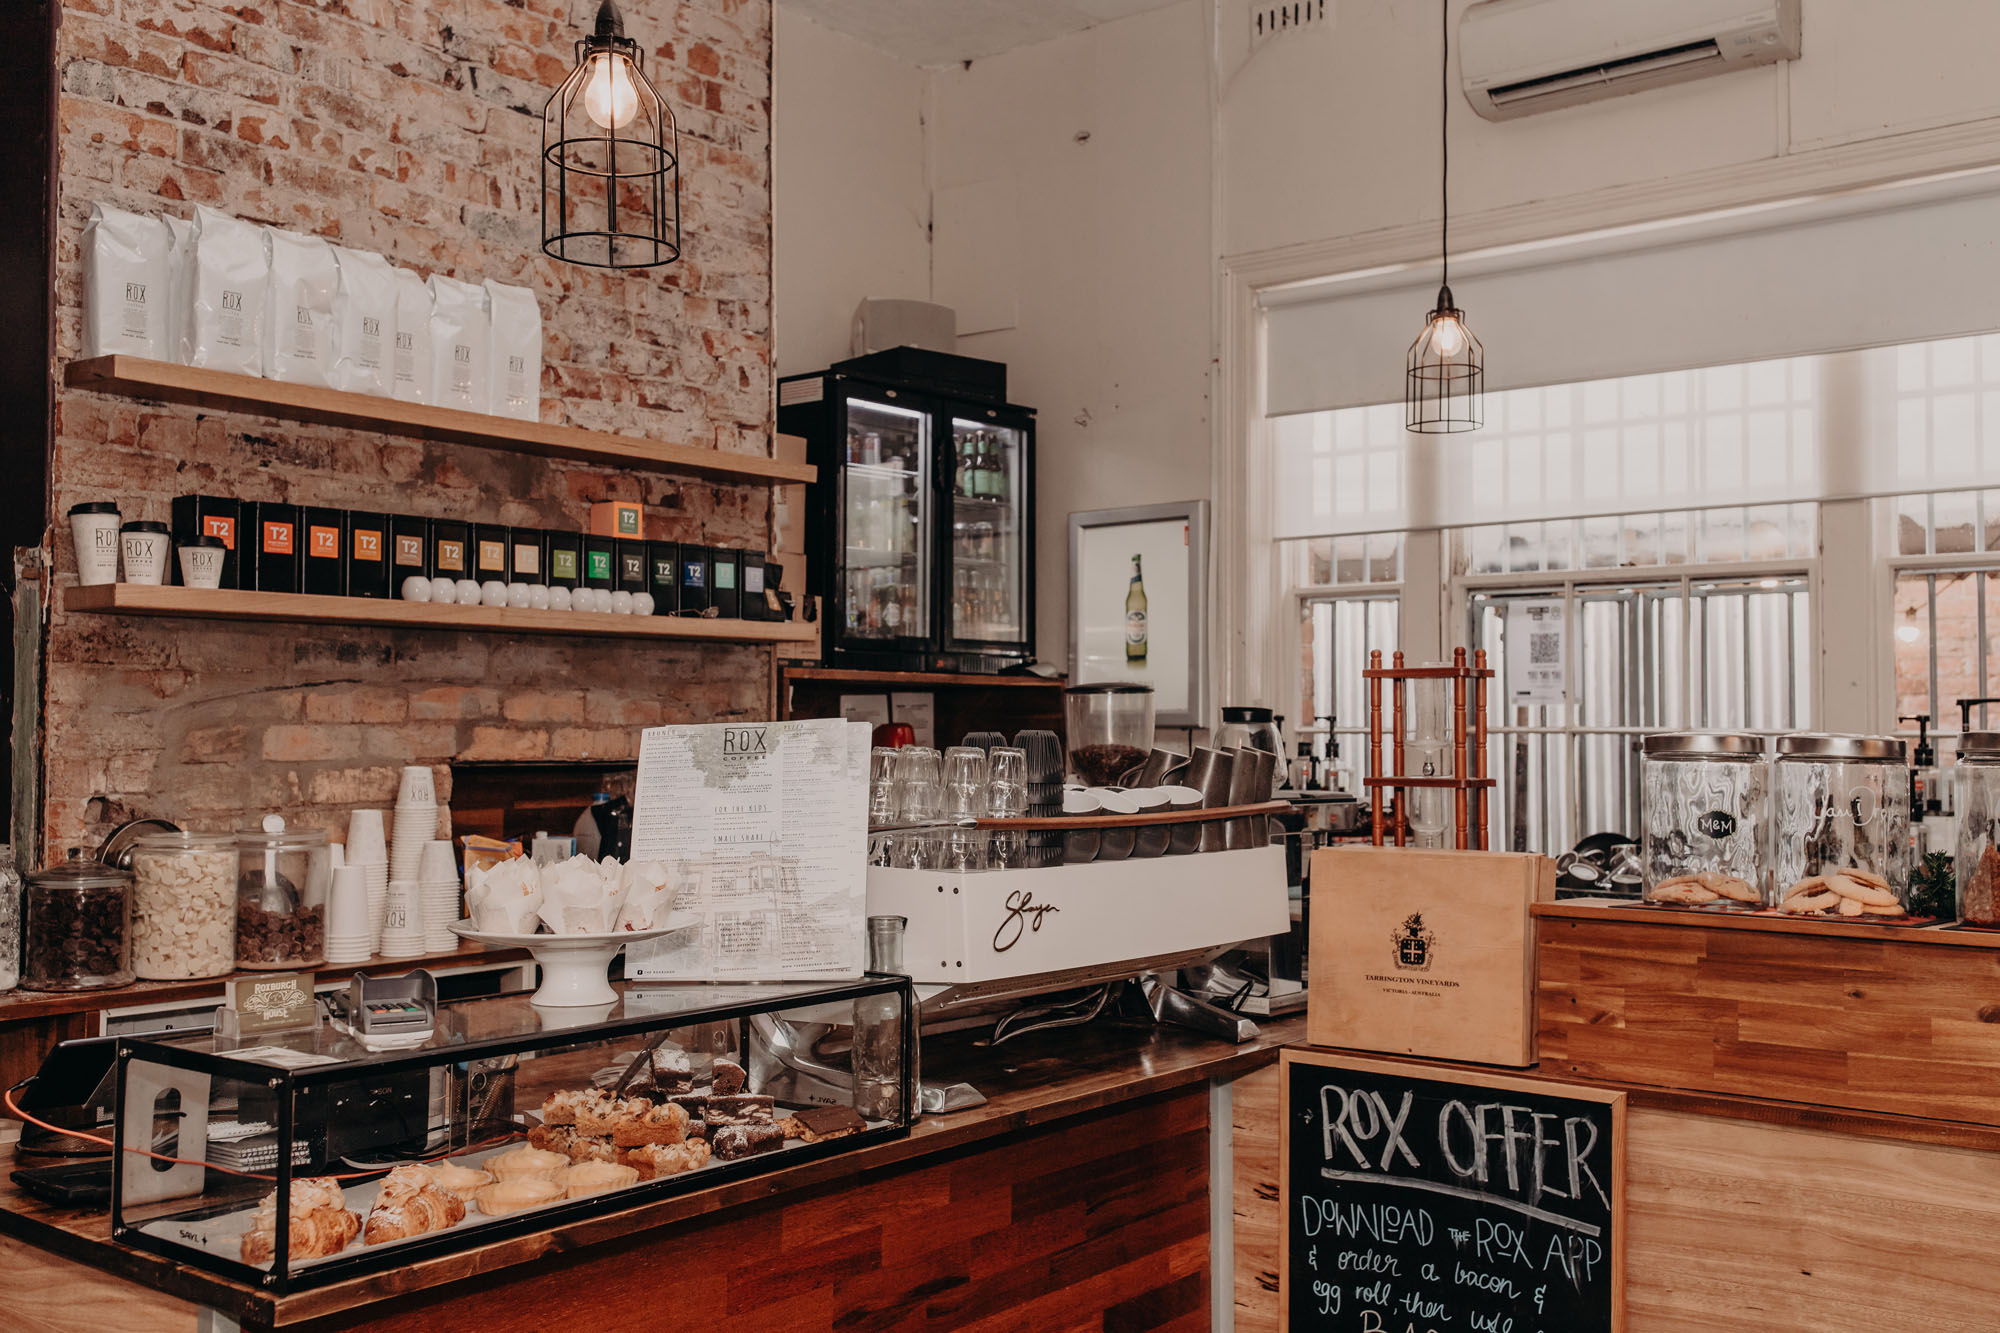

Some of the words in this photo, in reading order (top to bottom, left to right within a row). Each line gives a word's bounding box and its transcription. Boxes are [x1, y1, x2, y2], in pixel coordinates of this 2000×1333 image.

[126, 283, 146, 303] ROX
[222, 291, 242, 311] ROX
[363, 317, 380, 336] ROX
[396, 332, 413, 350] ROX
[455, 345, 471, 363] ROX
[622, 511, 636, 523] T2
[210, 521, 229, 536] T2
[270, 526, 288, 541] T2
[96, 529, 118, 547] ROX
[316, 532, 334, 546] T2
[360, 536, 377, 549] T2
[126, 540, 153, 557] ROX
[402, 540, 418, 553] T2
[444, 545, 460, 558] T2
[484, 546, 500, 559] T2
[192, 552, 213, 567] ROX
[558, 554, 572, 567] T2
[593, 555, 607, 568] T2
[626, 559, 640, 572] T2
[657, 562, 671, 575] T2
[687, 565, 701, 577] T2
[724, 729, 767, 752] ROX
[411, 788, 429, 801] ROX
[1700, 818, 1733, 834] M&M
[993, 890, 1061, 952] Slayer
[255, 979, 297, 995] ROXBURGH
[1364, 974, 1415, 984] TARRINGTON
[1416, 978, 1460, 988] VINEYARDS
[263, 1007, 289, 1021] HOUSE
[1320, 1084, 1421, 1171] ROX
[1438, 1100, 1612, 1212] OFFER
[1302, 1195, 1434, 1246] DOWNLOAD
[1448, 1228, 1472, 1244] THE
[1475, 1218, 1534, 1270] ROX
[1543, 1234, 1602, 1282] APP
[1338, 1248, 1402, 1278] order
[1421, 1263, 1441, 1282] a
[1455, 1261, 1522, 1300] bacon
[1312, 1280, 1342, 1315] egg
[1399, 1291, 1453, 1322] then
